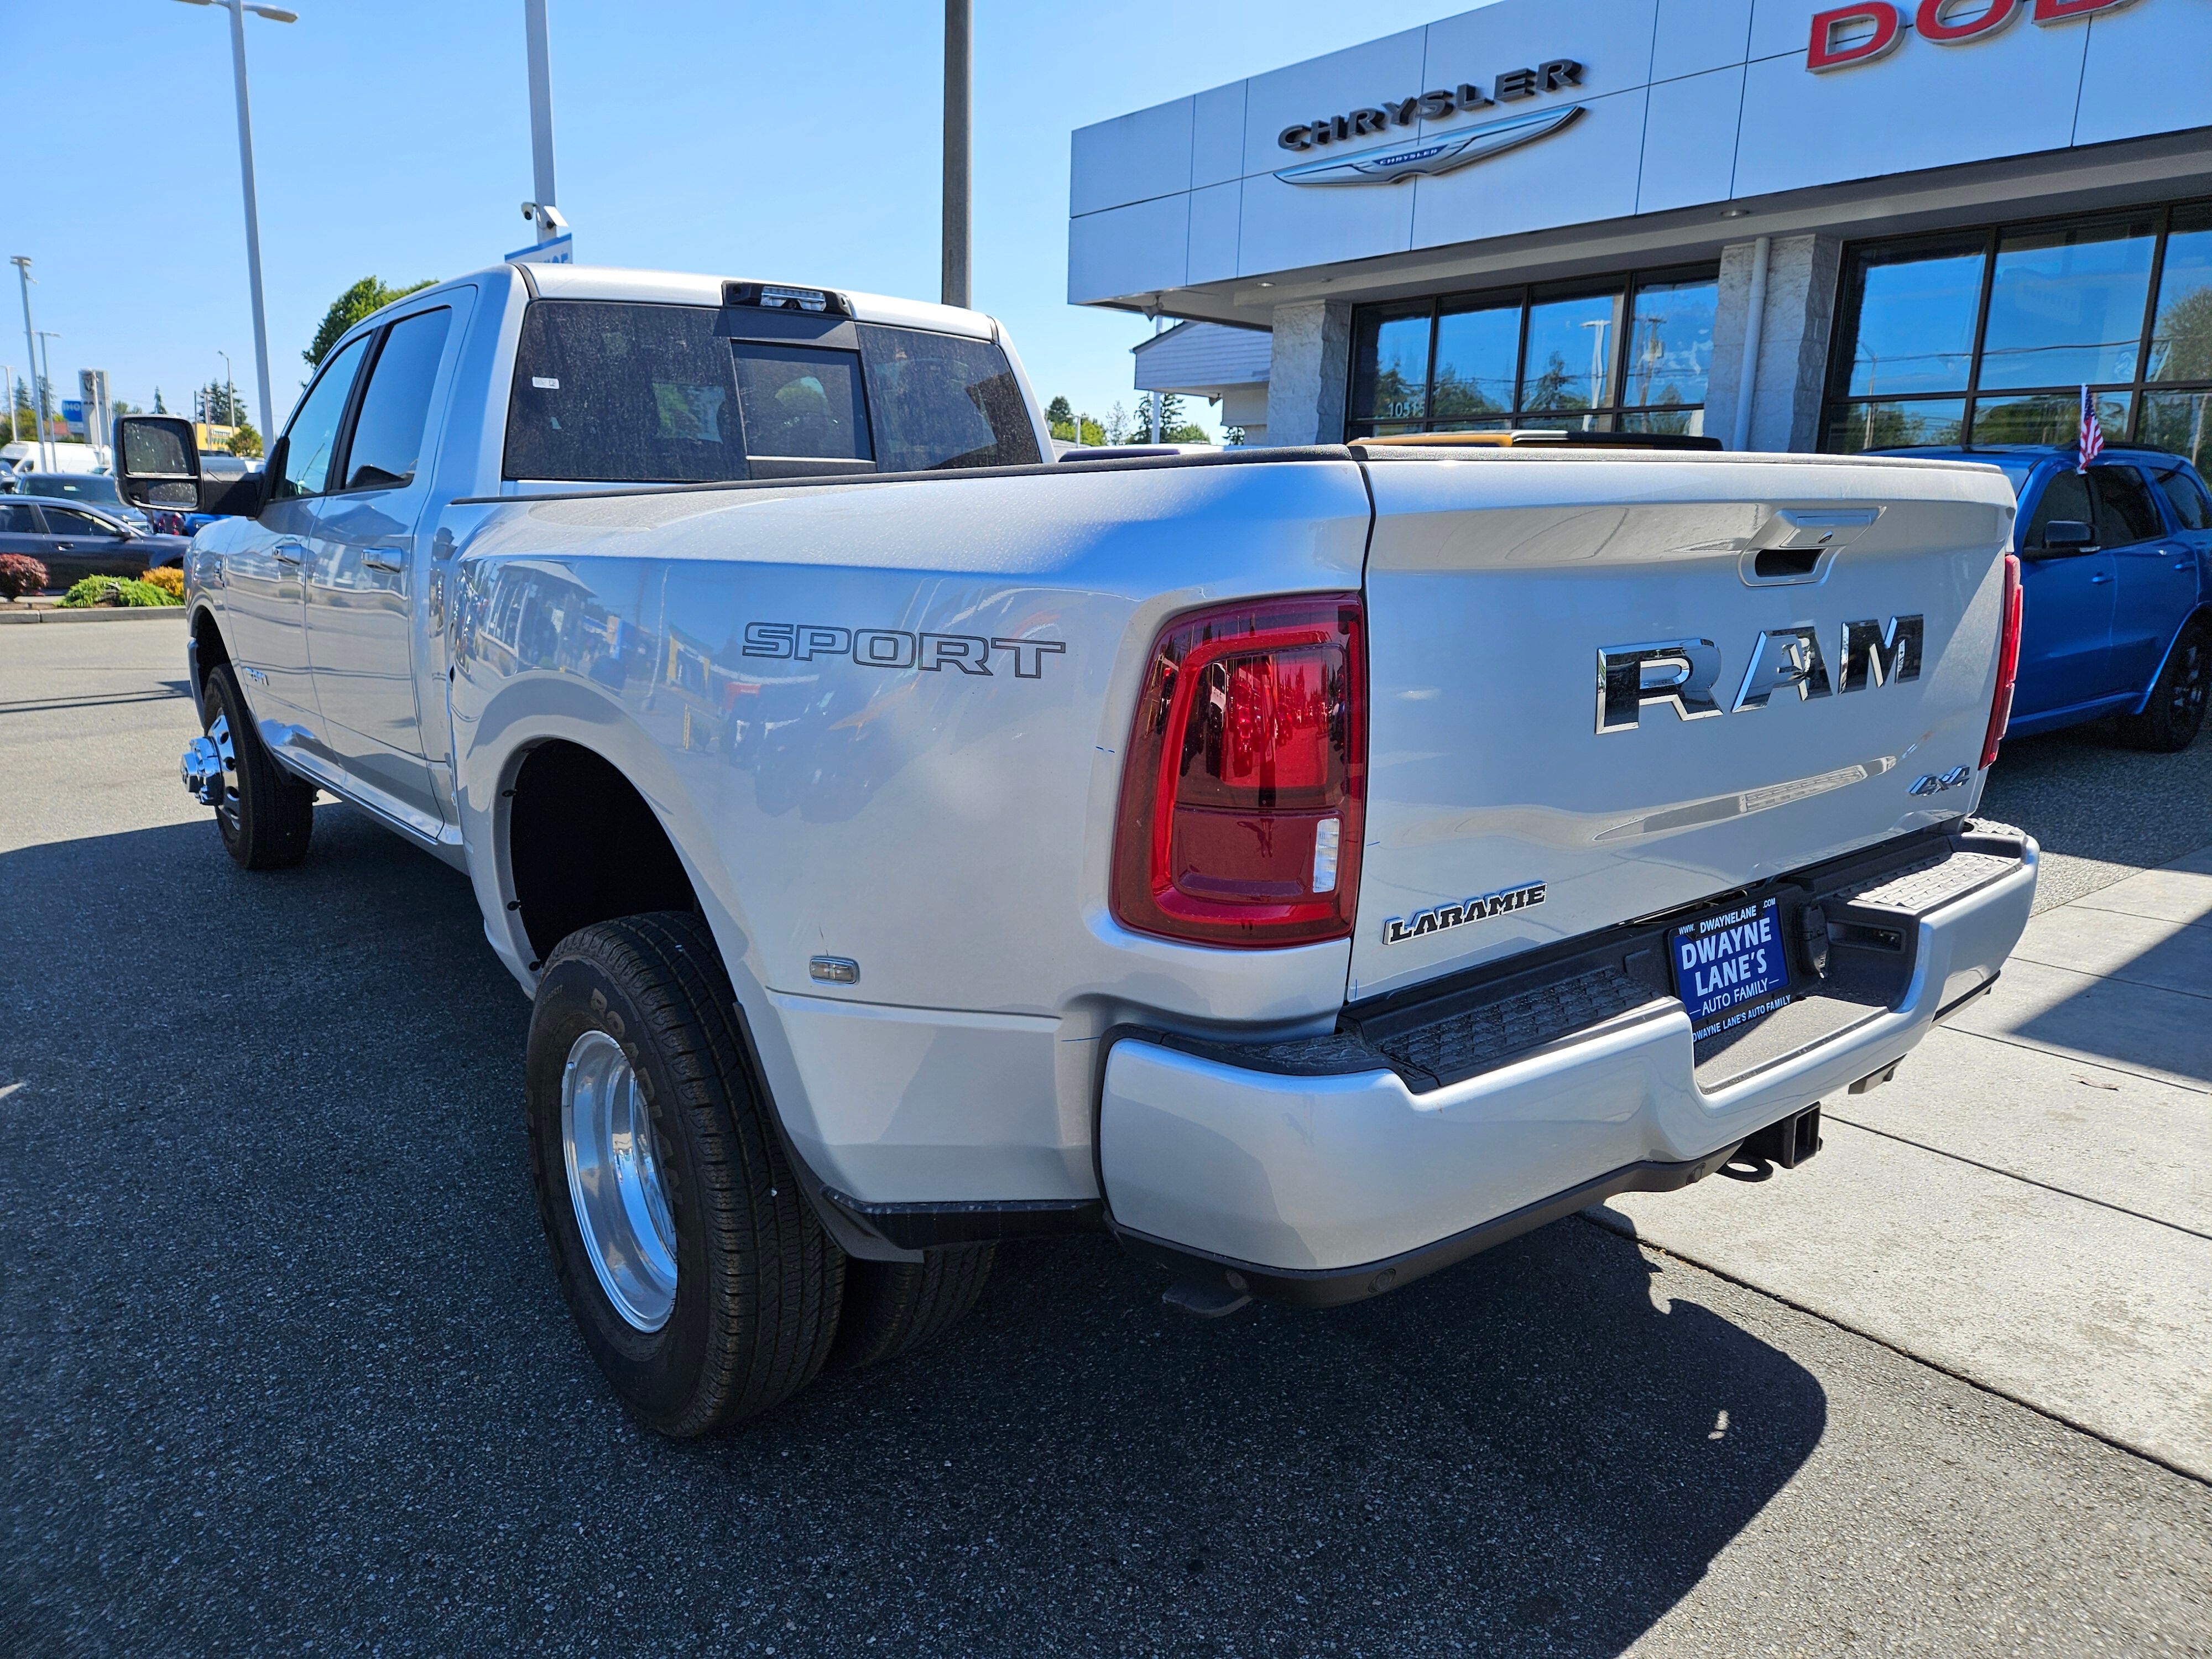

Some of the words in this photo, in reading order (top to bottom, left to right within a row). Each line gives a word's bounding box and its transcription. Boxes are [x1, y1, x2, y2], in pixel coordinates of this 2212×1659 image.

[1806, 0, 2129, 74] DO
[1277, 58, 1583, 152] CHRYSLER
[1380, 148, 1438, 165] CHRYSLER
[61, 402, 81, 412] IHO
[1388, 401, 1425, 417] 10515
[742, 622, 1066, 679] SPORT
[1595, 614, 1924, 734] RAM
[1385, 881, 1548, 945] LARAMIE
[1700, 905, 1757, 933] DWAYNELANE
[1681, 917, 1772, 970] DWAYNE
[1695, 948, 1767, 997] LANE'S
[1702, 993, 1731, 1016] AUTO
[1733, 978, 1769, 1003] FAMILY
[1692, 1022, 1721, 1043] DWAYNE
[1723, 1013, 1746, 1030] LANE'S
[1747, 1005, 1765, 1022] AUTO
[1766, 995, 1791, 1012] FAMILY
